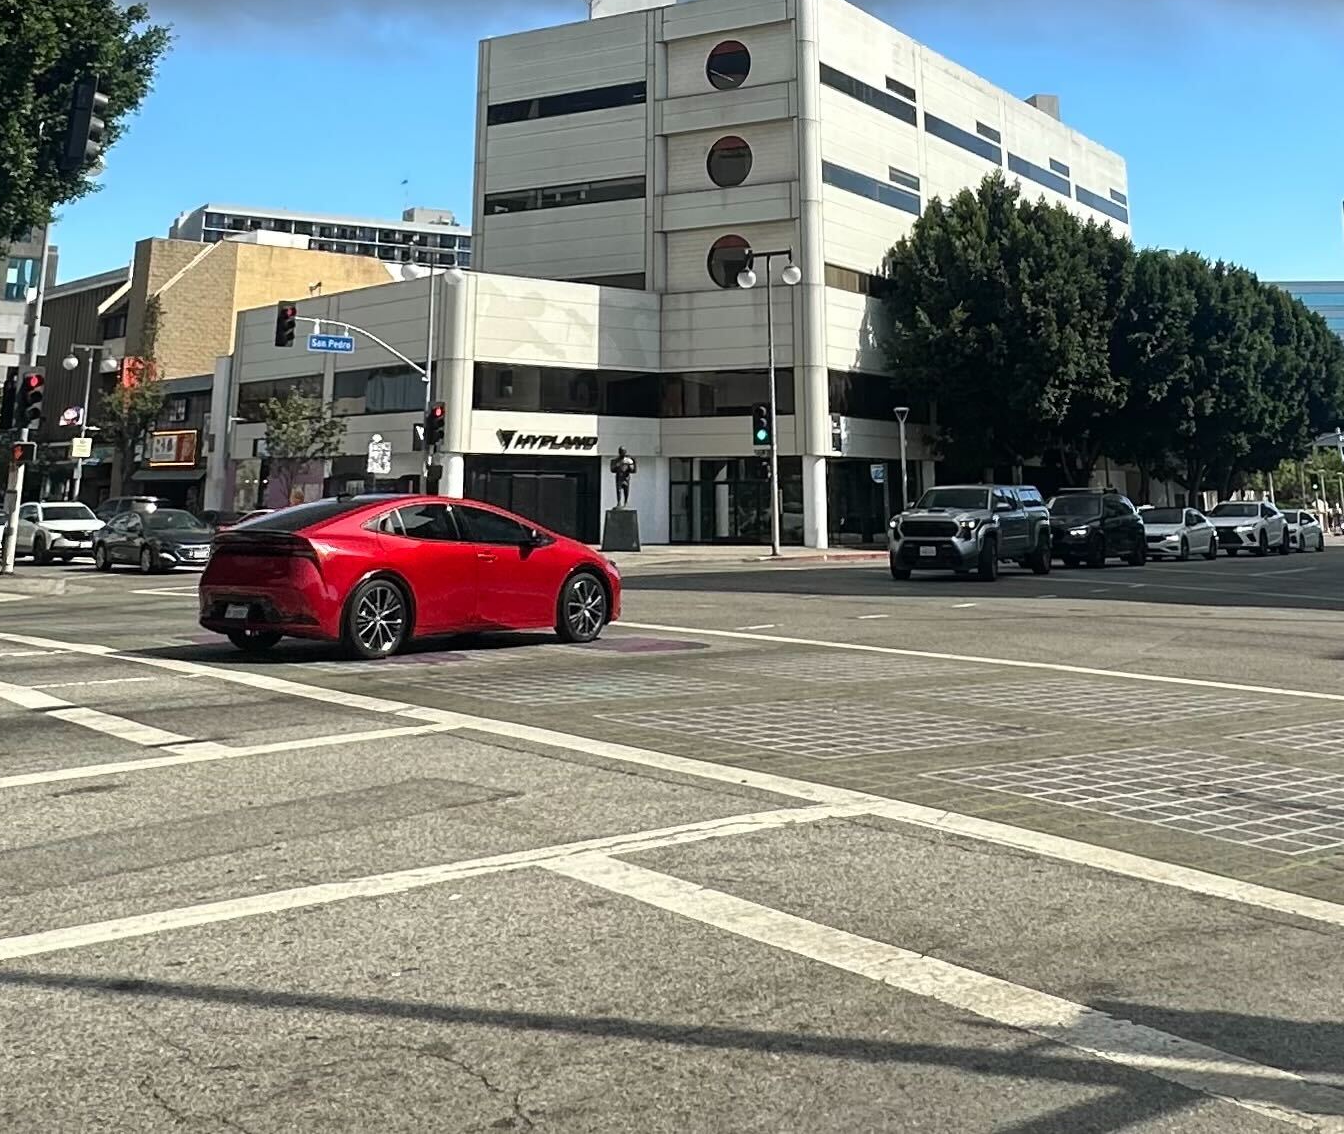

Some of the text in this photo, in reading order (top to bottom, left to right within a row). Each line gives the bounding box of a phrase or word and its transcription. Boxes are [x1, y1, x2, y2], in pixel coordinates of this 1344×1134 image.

[312, 338, 351, 349] San Pedro
[514, 434, 599, 451] HYPLAND
